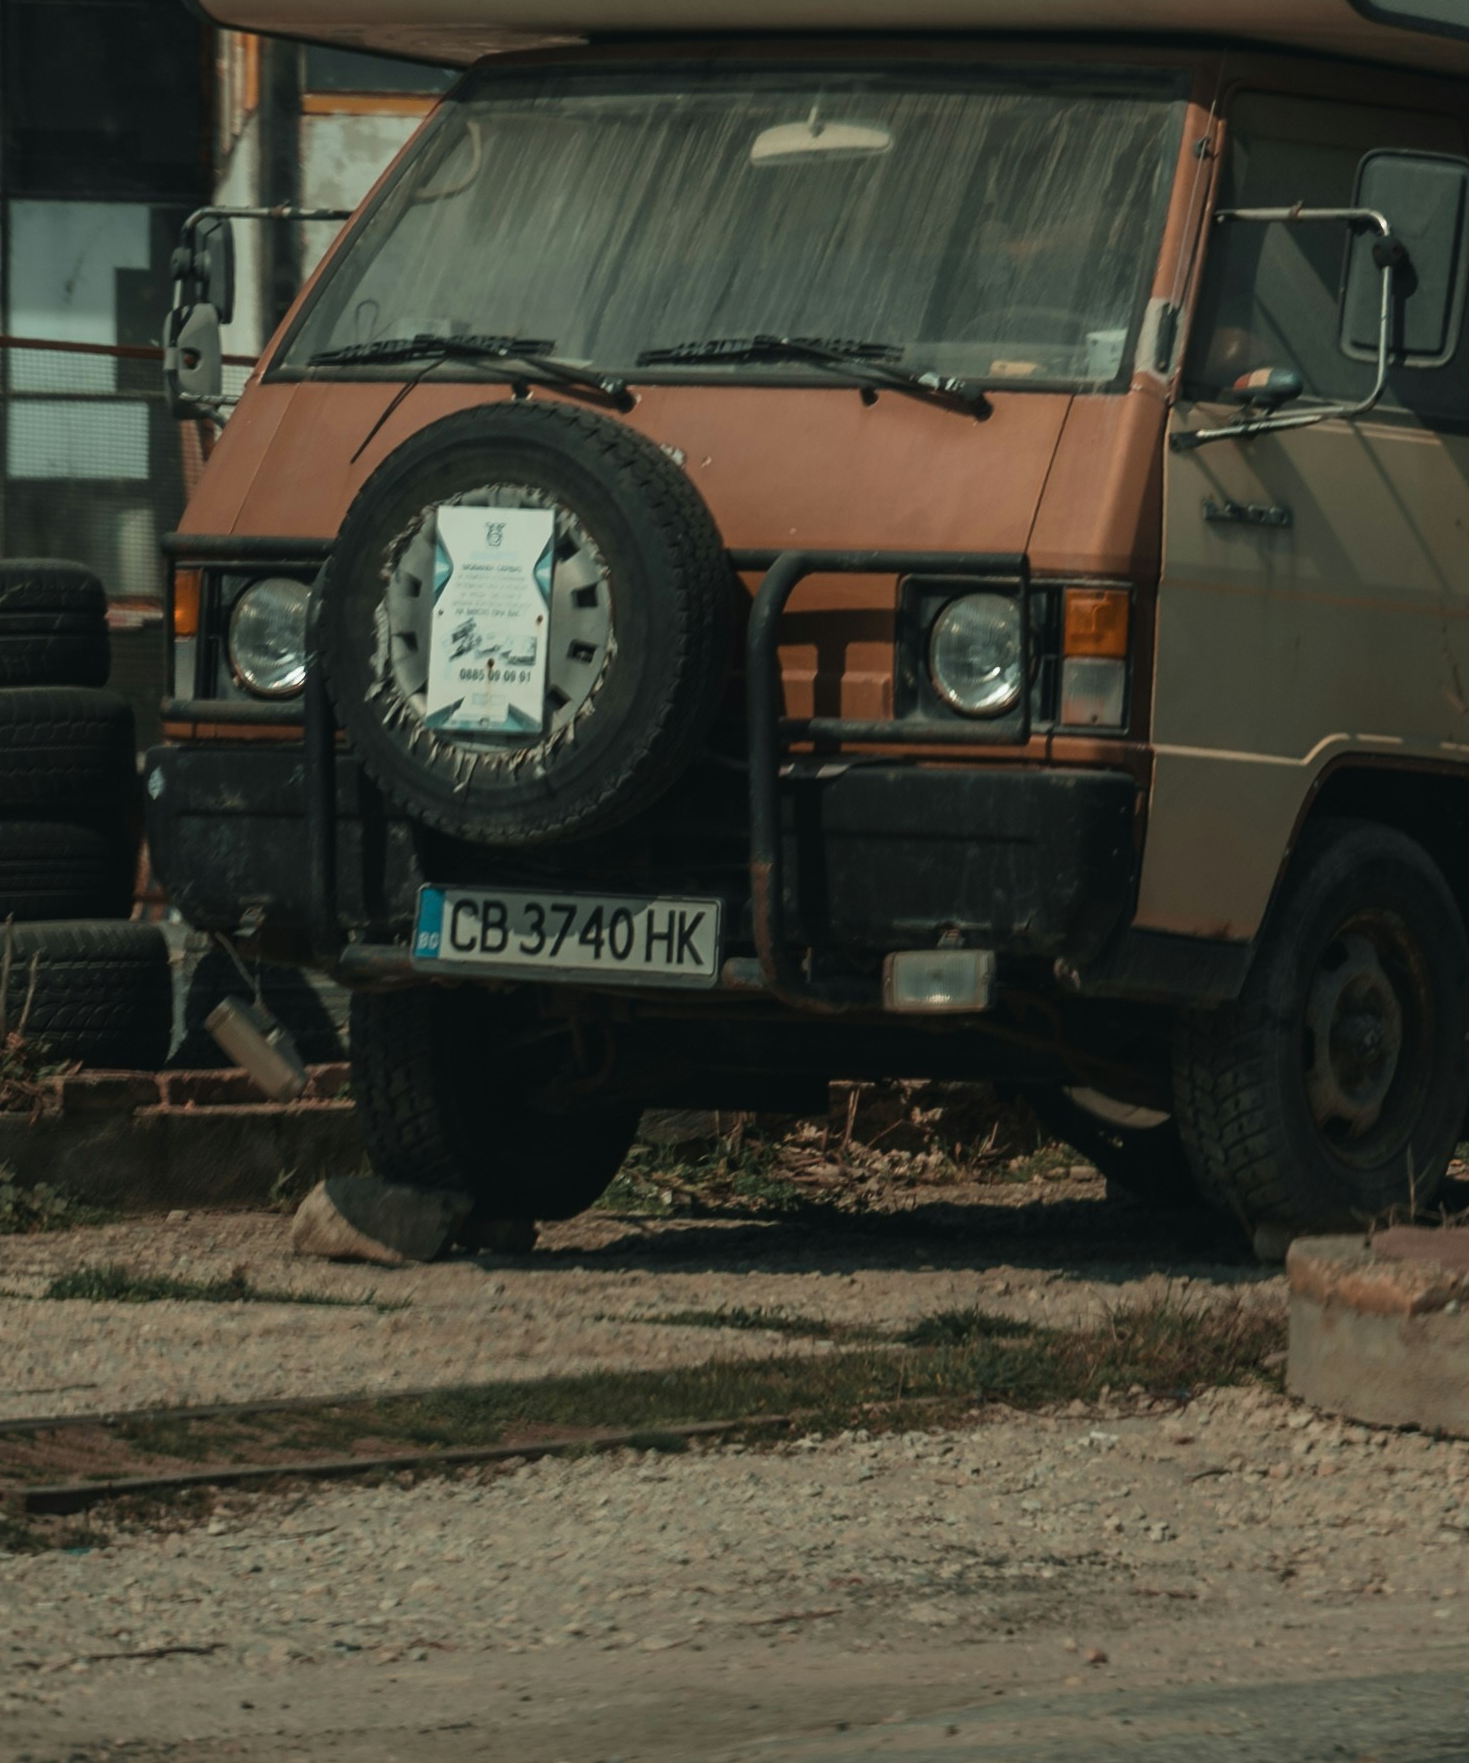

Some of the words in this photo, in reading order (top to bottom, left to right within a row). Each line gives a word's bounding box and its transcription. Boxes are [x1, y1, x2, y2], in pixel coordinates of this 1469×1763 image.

[450, 898, 509, 954] CB
[520, 903, 635, 961] 3740
[644, 909, 705, 966] HK
